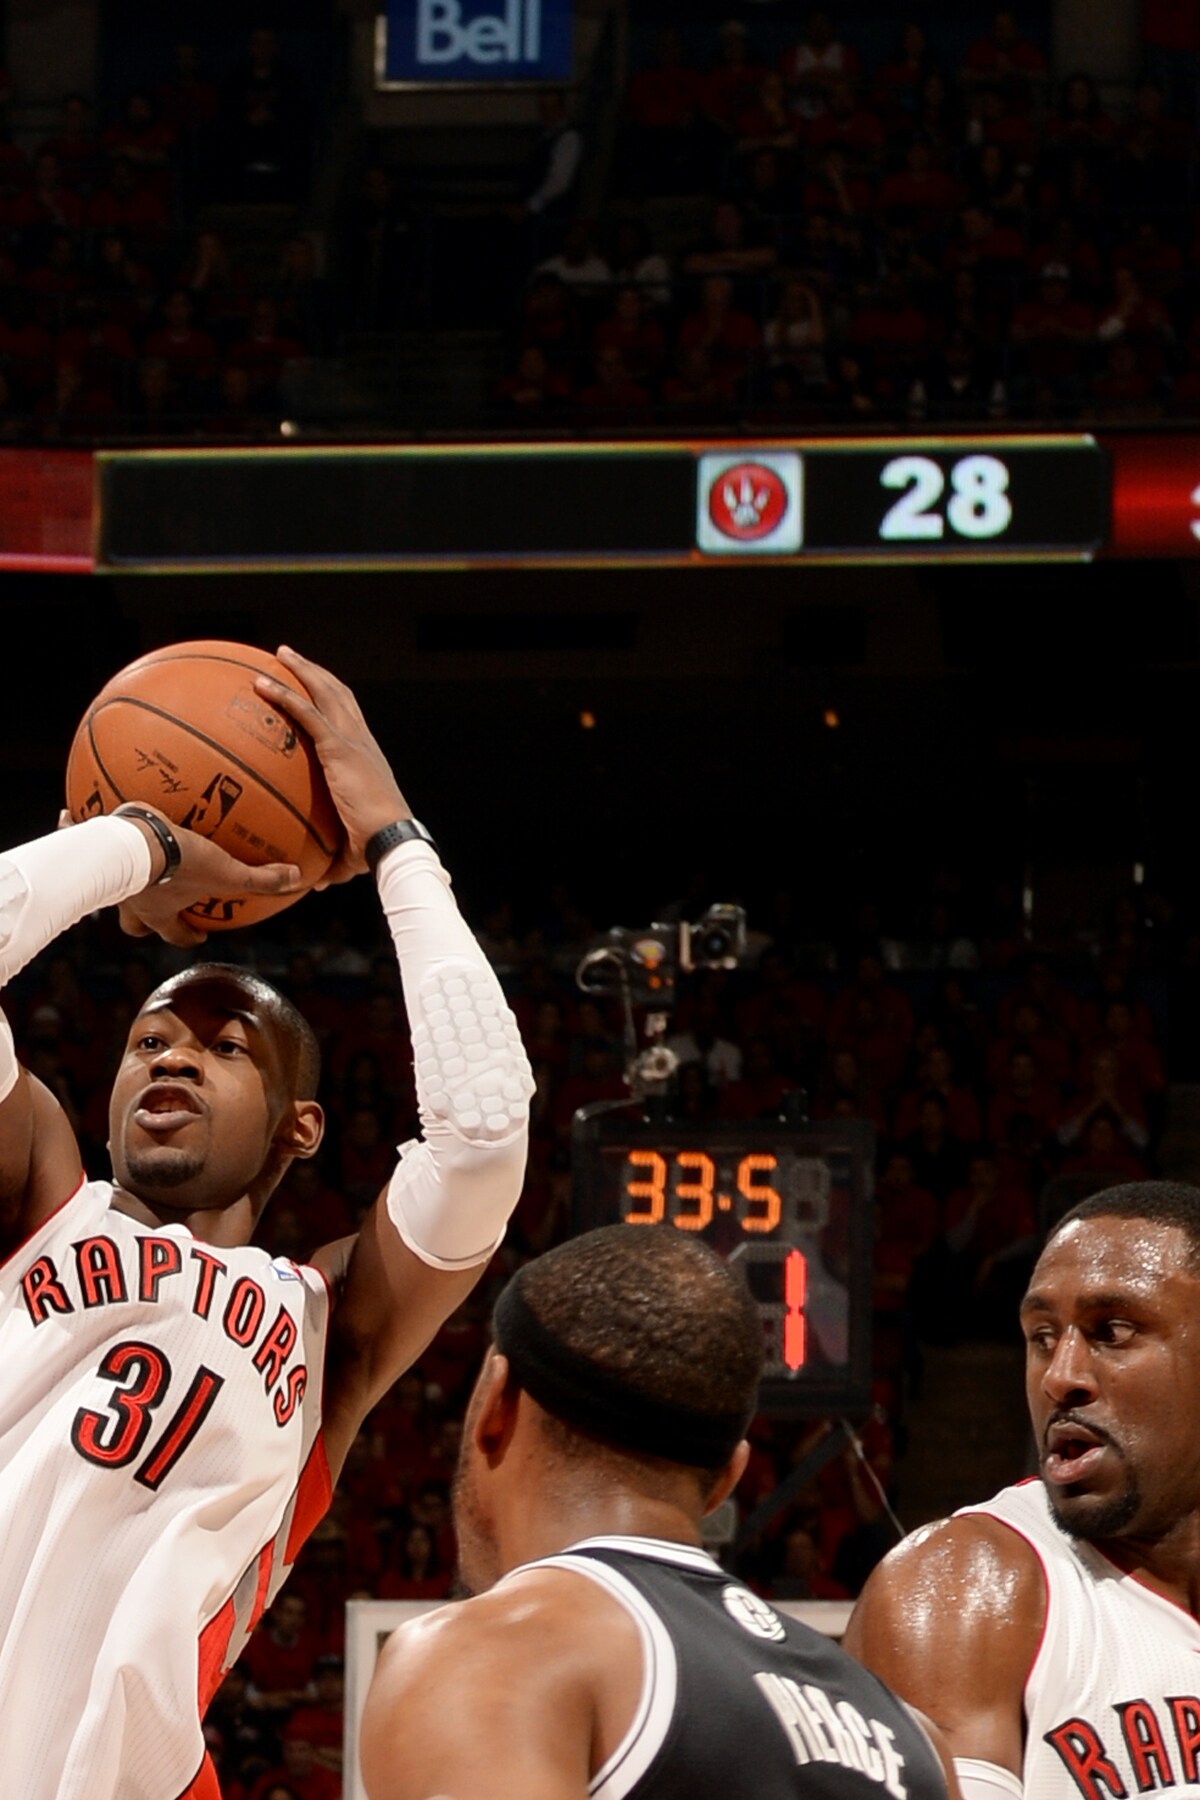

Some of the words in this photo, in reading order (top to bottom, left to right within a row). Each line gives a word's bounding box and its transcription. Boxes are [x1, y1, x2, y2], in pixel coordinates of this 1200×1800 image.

[416, 0, 541, 63] Bell
[879, 455, 1012, 540] 28
[21, 1234, 307, 1428] RAPTORS
[70, 1340, 226, 1492] 31
